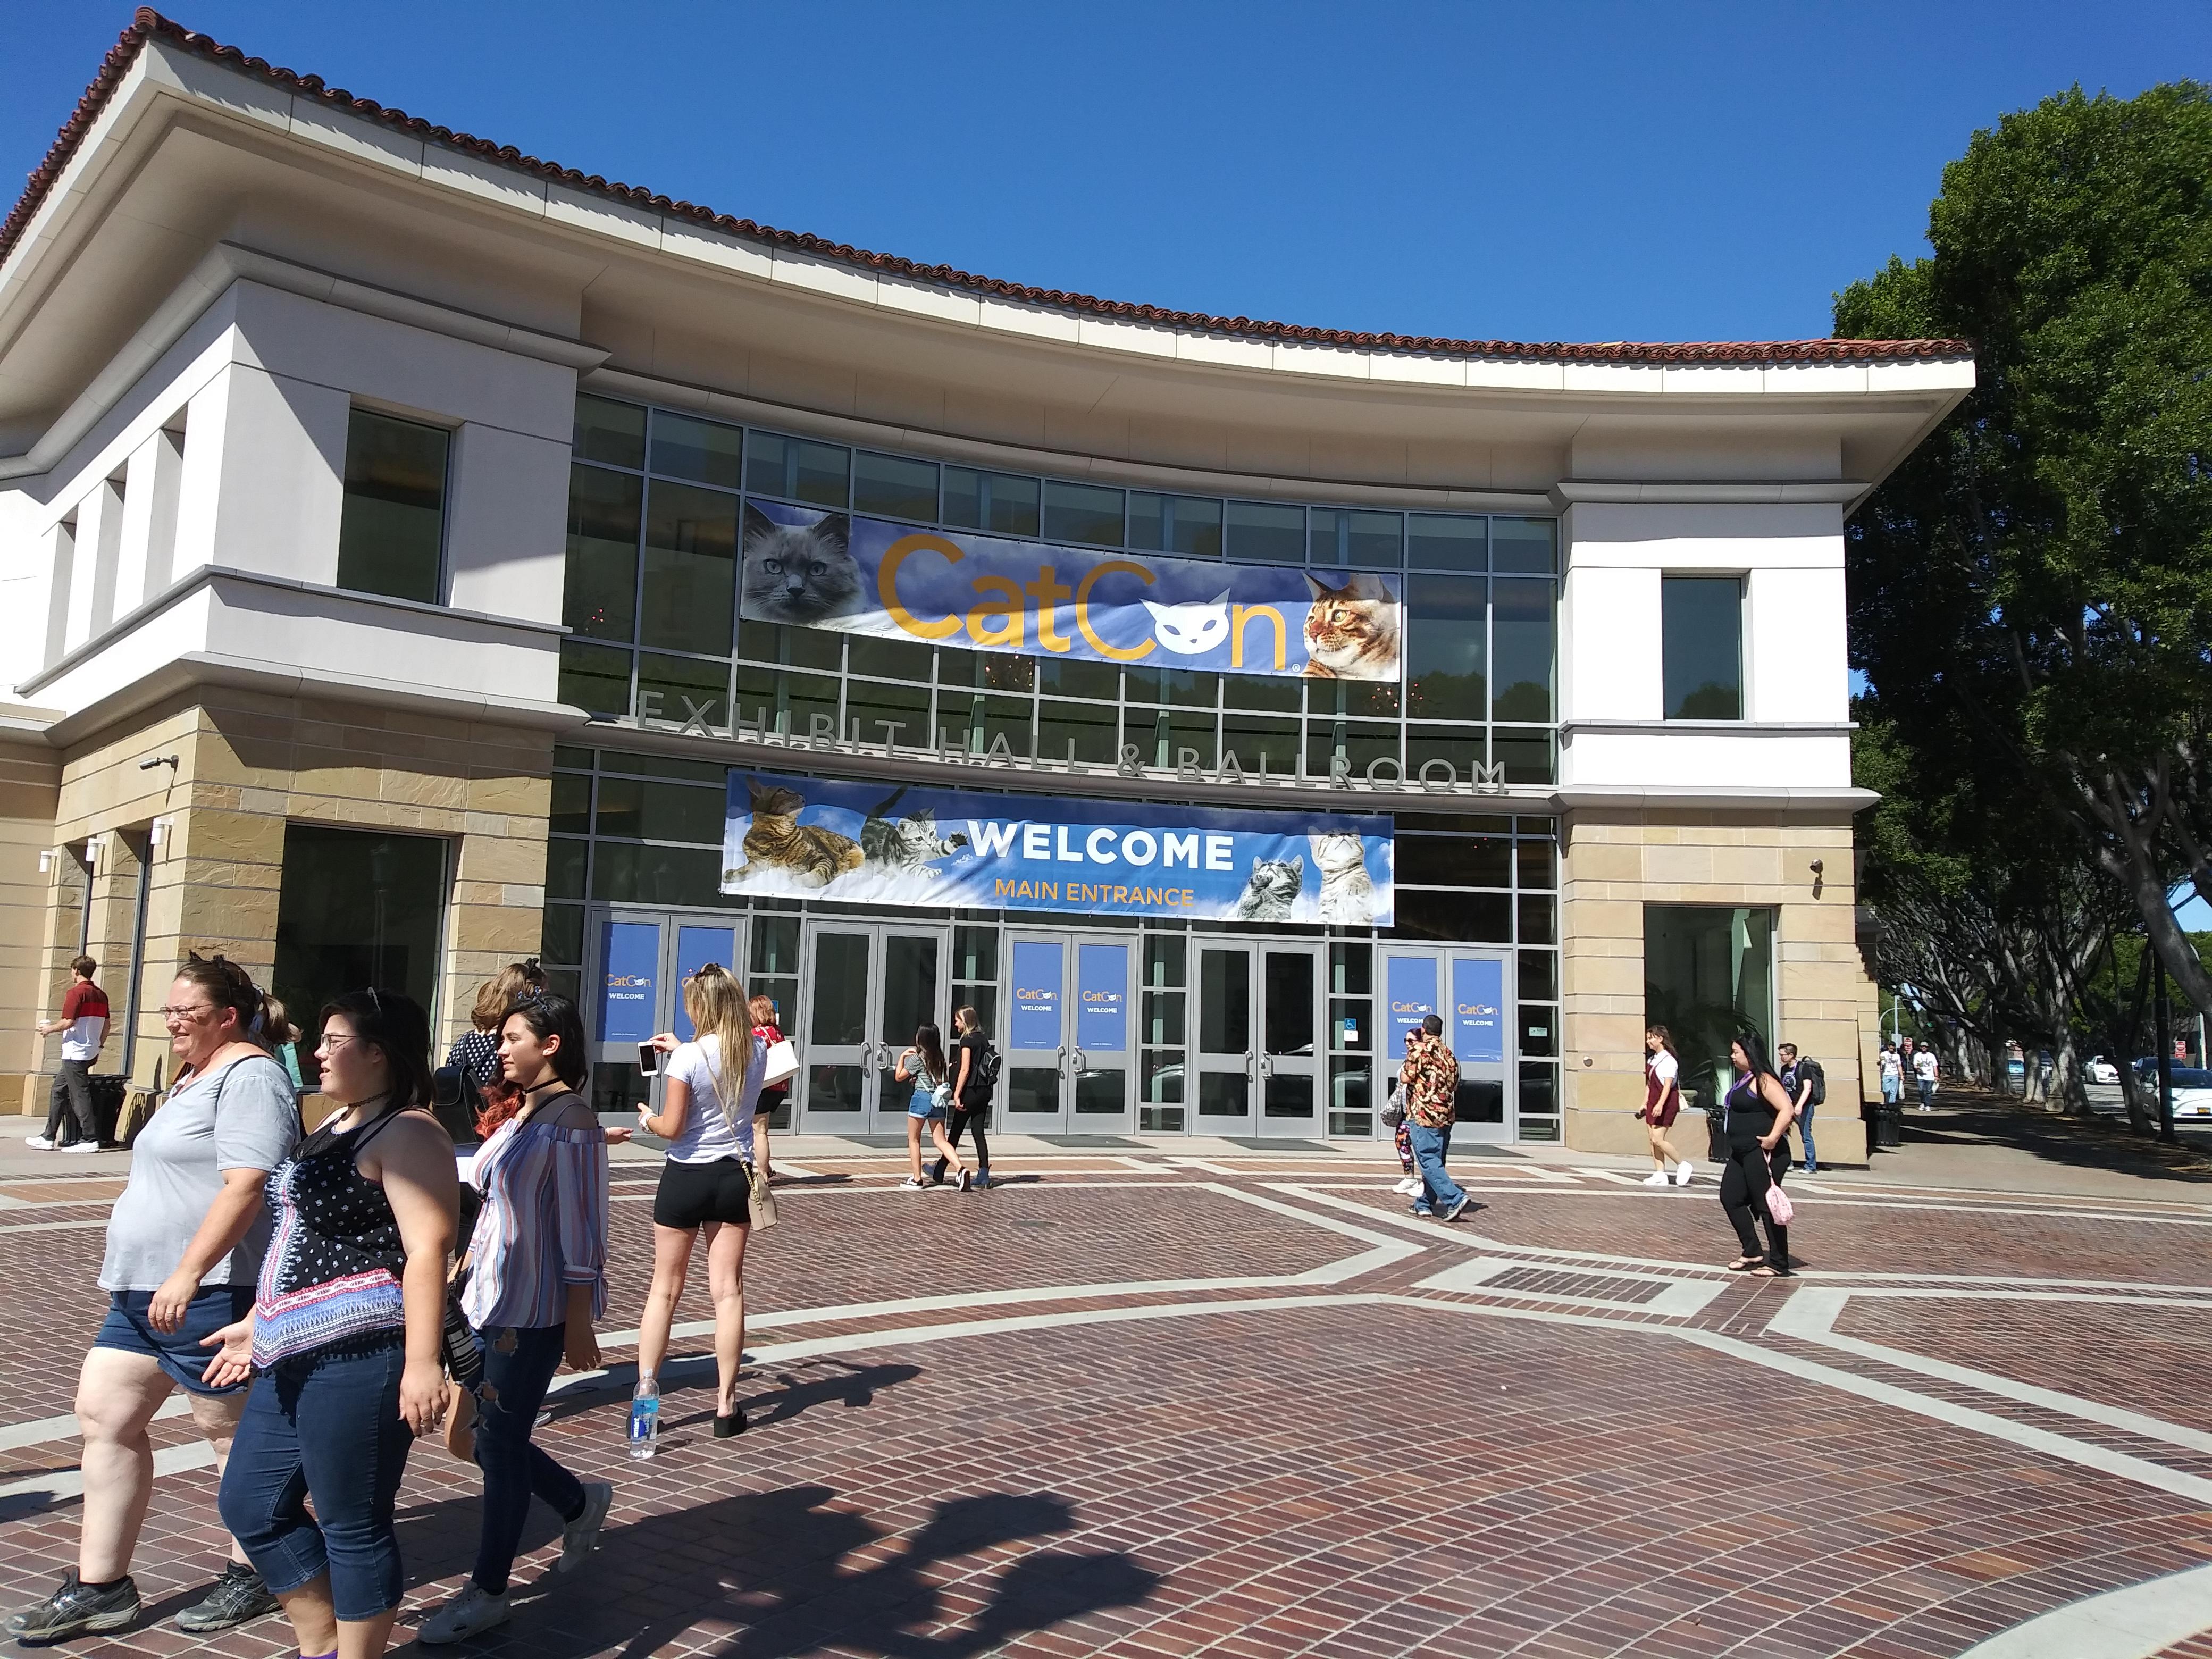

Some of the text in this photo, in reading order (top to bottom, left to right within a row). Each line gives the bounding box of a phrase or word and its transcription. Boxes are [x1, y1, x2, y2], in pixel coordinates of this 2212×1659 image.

[877, 533, 1287, 672] CatCon
[637, 690, 1507, 795] EXHIBIT HALL & BALLROOM
[966, 819, 1234, 871] WELCOME
[994, 879, 1194, 907] MAIN ENTRANCE
